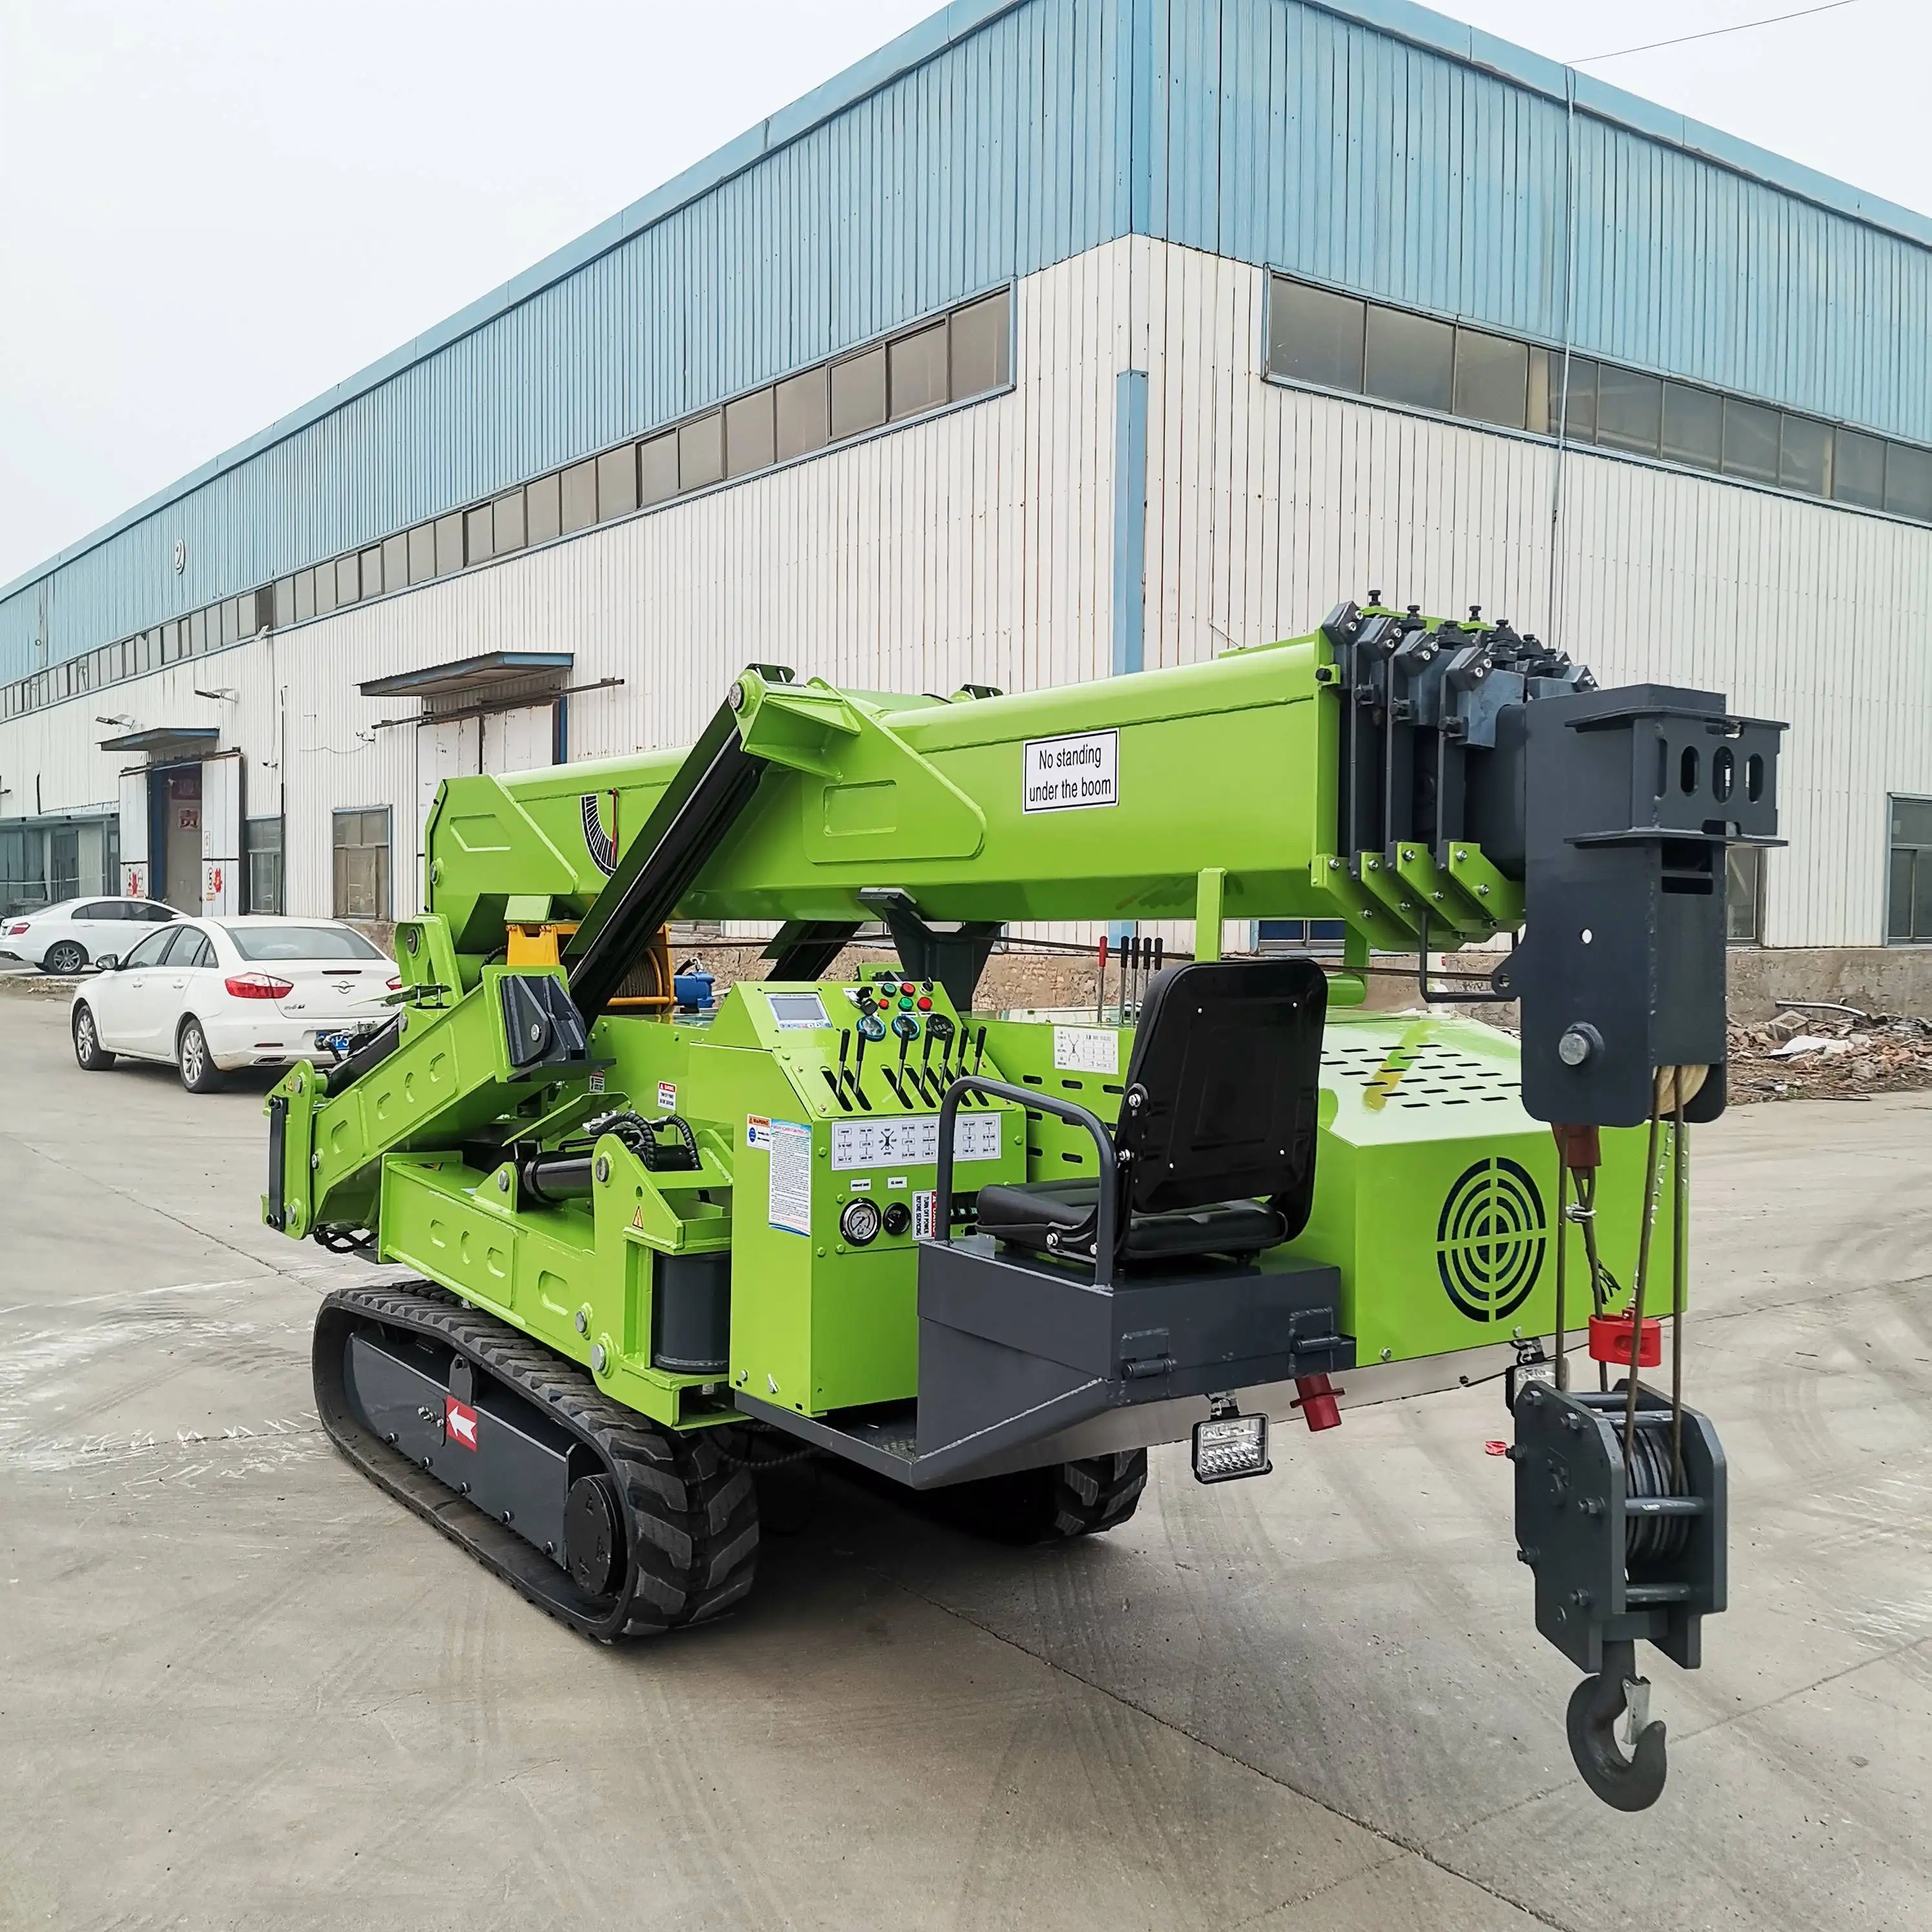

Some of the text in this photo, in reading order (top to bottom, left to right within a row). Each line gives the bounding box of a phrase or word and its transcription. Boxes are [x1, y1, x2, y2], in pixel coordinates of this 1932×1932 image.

[1039, 745, 1102, 770] No standing
[1029, 777, 1111, 802] under the boom
